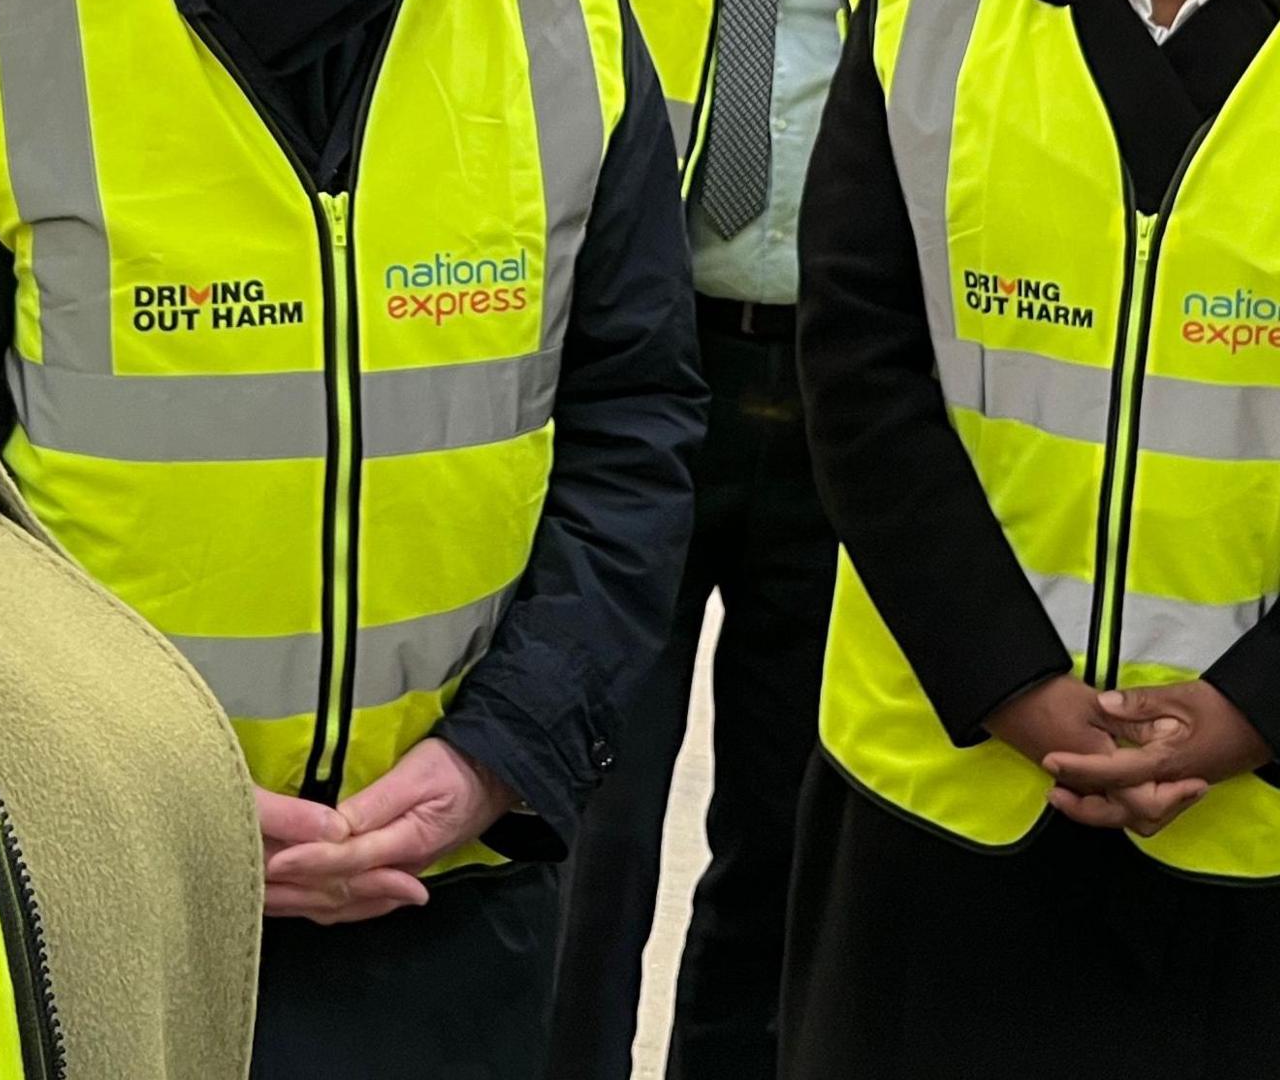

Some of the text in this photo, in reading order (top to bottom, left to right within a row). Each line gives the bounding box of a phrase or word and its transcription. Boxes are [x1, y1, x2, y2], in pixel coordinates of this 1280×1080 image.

[385, 247, 526, 289] national
[134, 279, 265, 308] DRIVING
[964, 269, 1061, 303] DRIVING
[133, 300, 304, 333] OUT HARM
[387, 286, 527, 327] express
[1016, 299, 1094, 329] HARM
